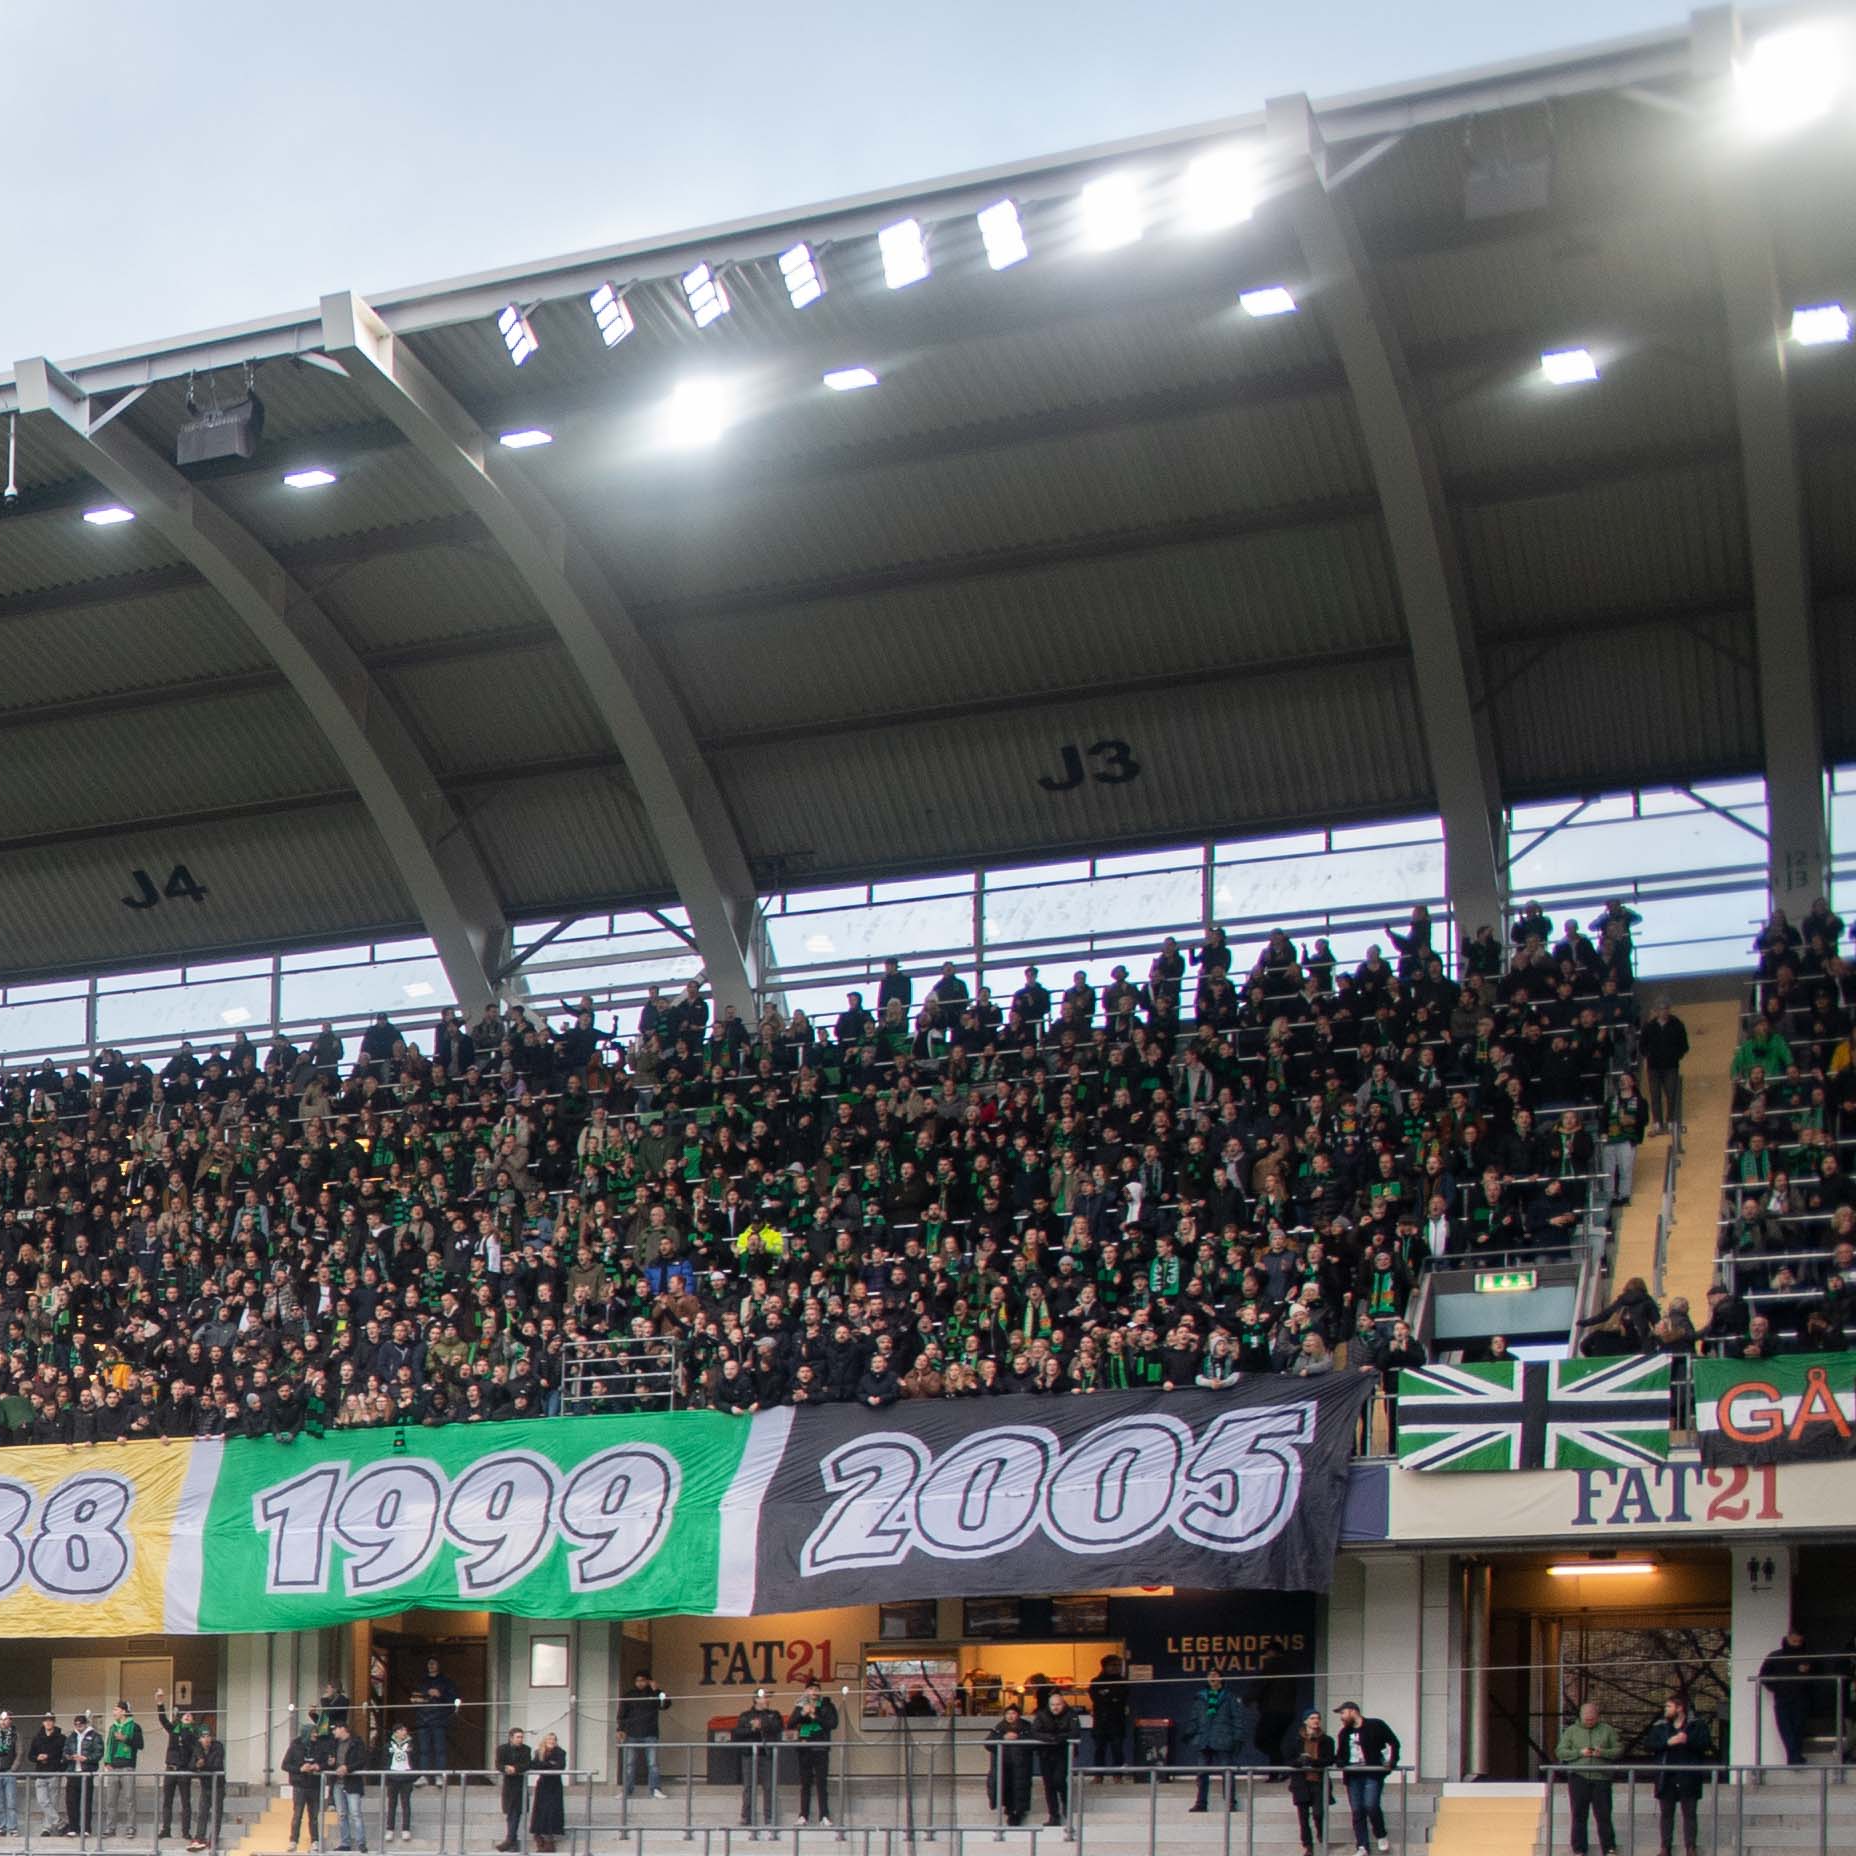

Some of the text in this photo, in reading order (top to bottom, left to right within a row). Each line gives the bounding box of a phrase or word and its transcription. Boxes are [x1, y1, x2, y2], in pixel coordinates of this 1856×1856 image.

[1036, 739, 1142, 793] J3
[120, 862, 207, 911] J4
[799, 1399, 1320, 1578] 2005
[1571, 1461, 1784, 1526] FAT21
[254, 1441, 683, 1597] 1999
[699, 1640, 834, 1685] FAT21
